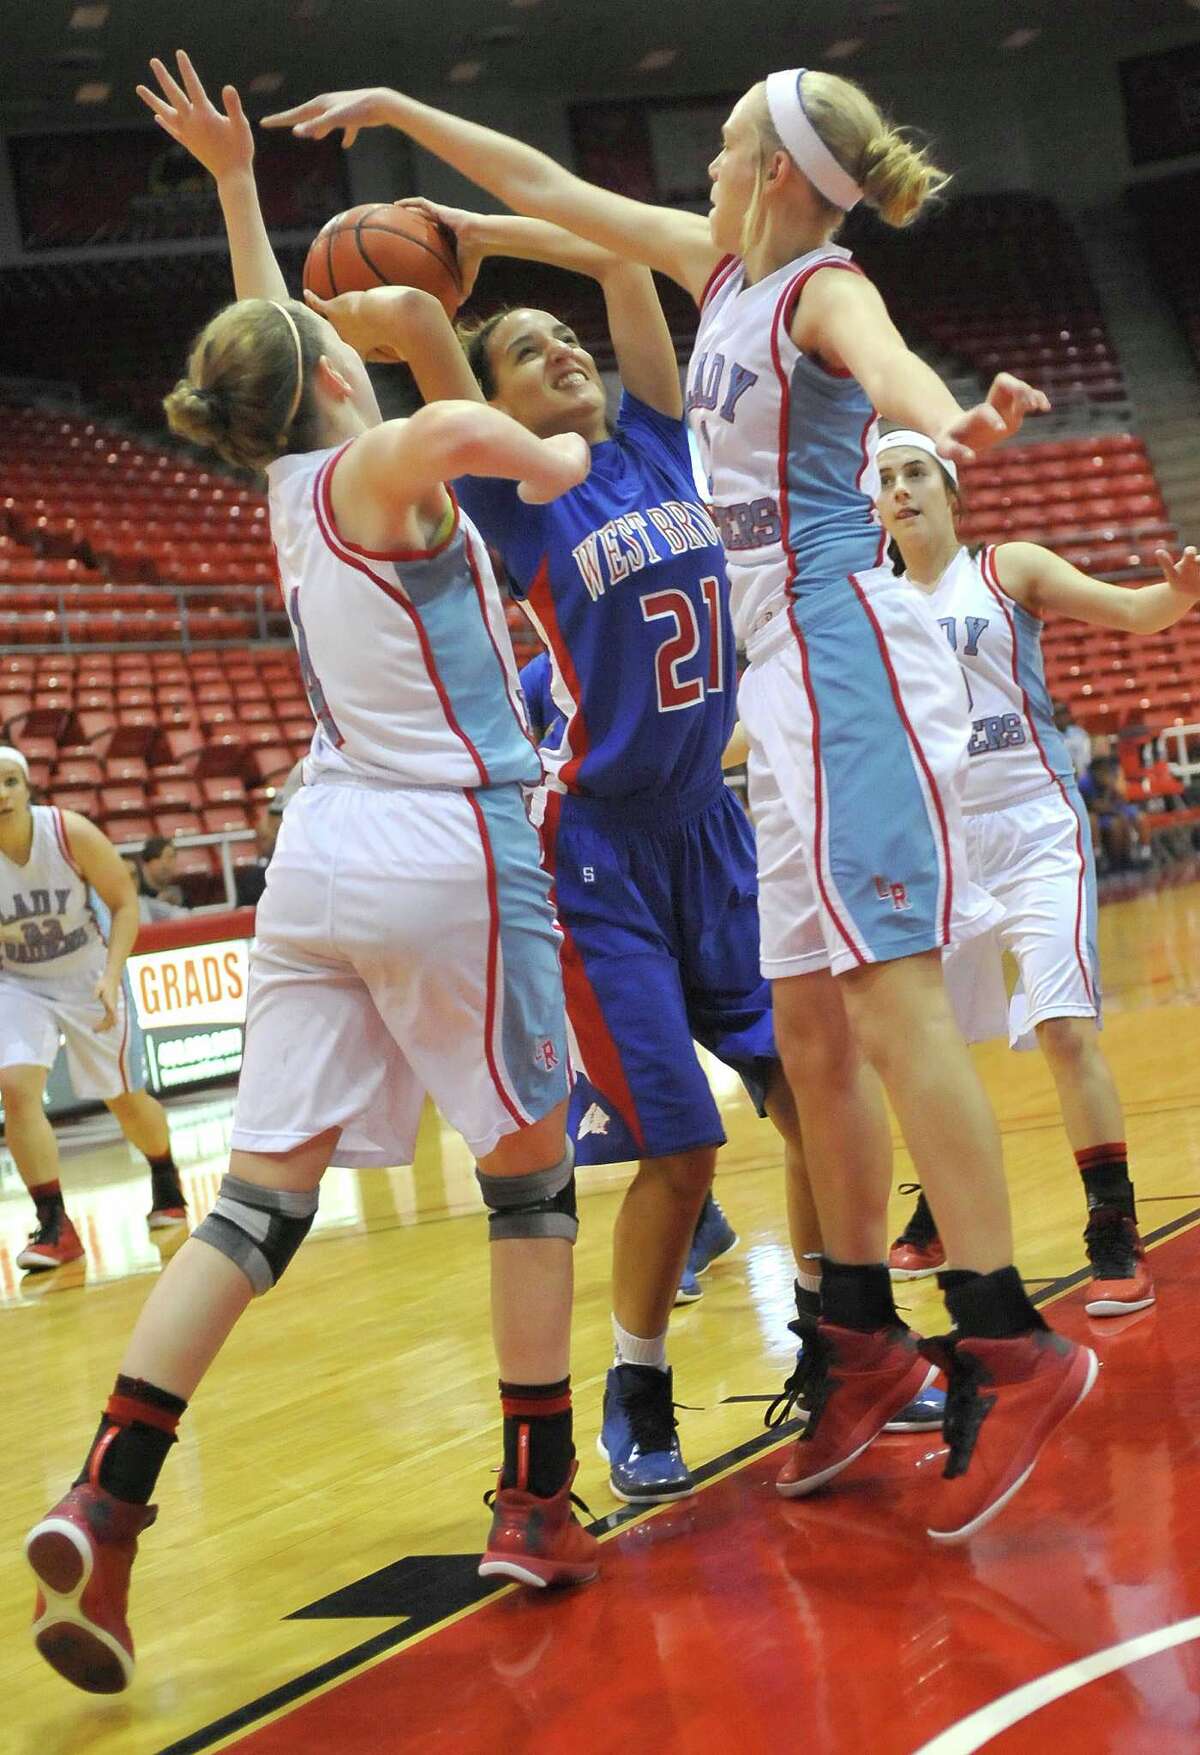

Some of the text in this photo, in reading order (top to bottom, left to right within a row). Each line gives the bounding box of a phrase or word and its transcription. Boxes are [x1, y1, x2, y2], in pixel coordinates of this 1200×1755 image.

[572, 500, 720, 602] WEST BRO
[639, 575, 724, 713] 21
[583, 866, 595, 883] S
[138, 951, 244, 1015] GRADS
